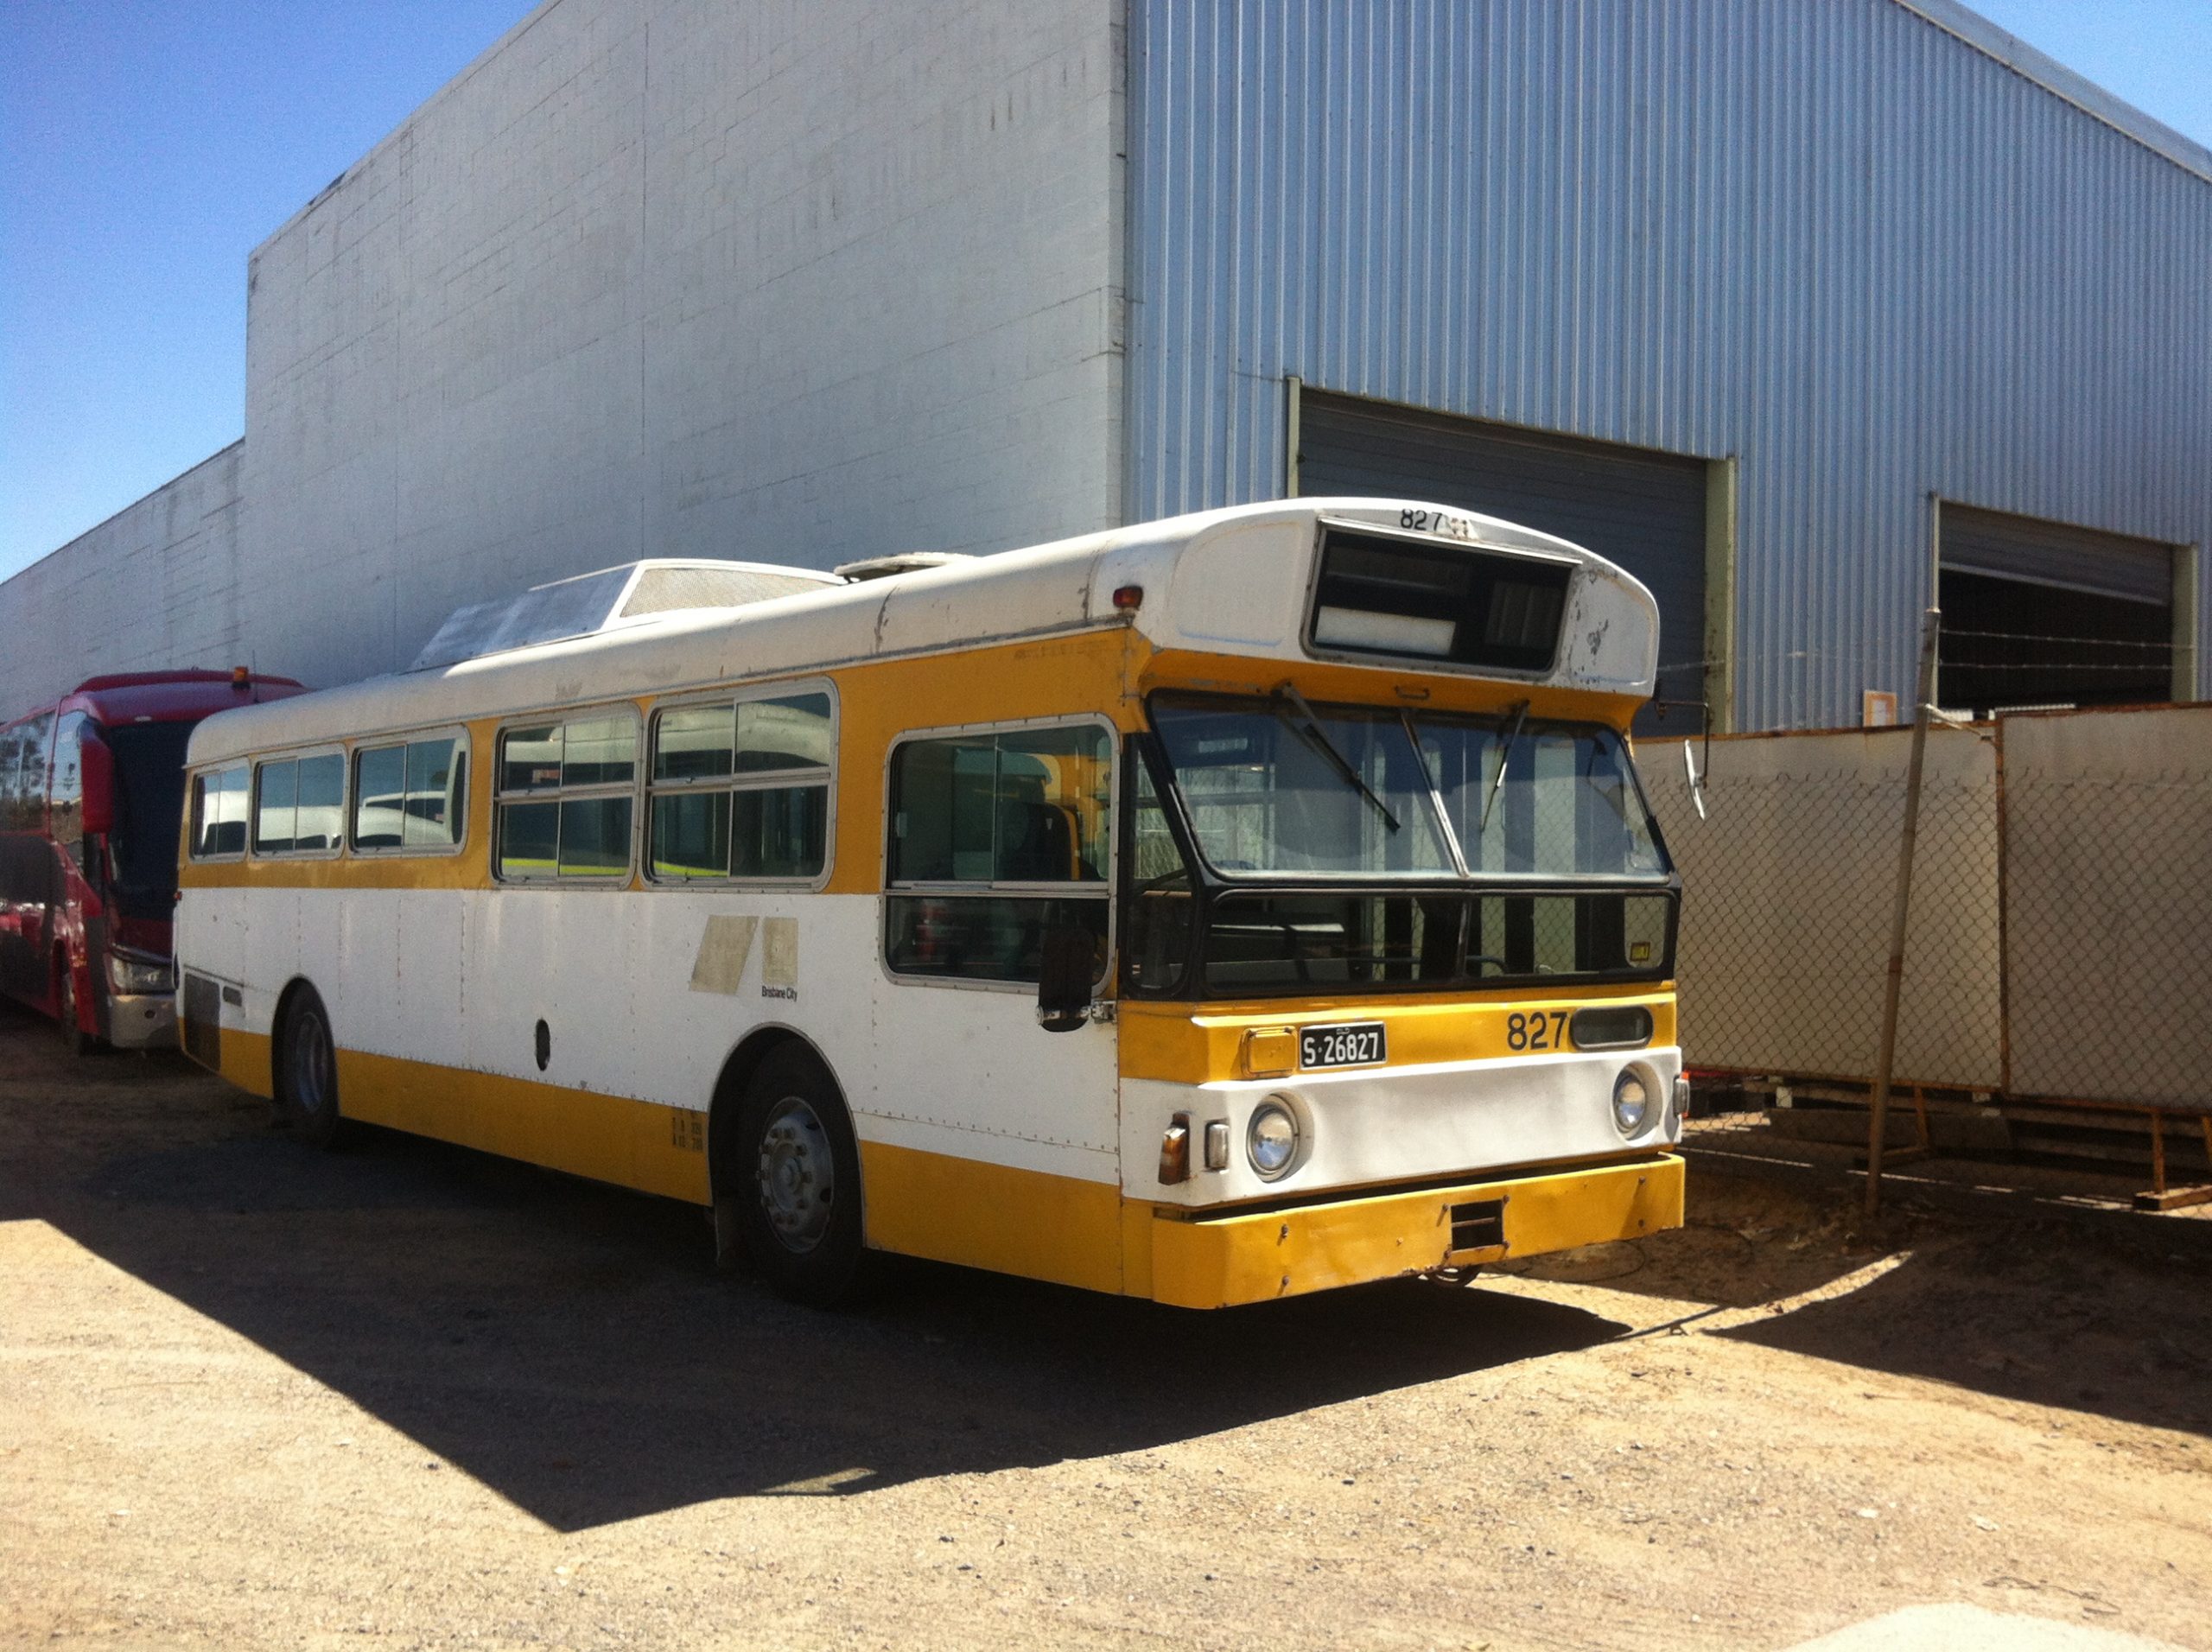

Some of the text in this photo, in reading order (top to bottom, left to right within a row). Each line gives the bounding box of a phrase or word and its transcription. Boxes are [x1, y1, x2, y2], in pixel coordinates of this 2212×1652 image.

[1401, 509, 1442, 531] 827
[761, 986, 798, 1002] Brisbane City
[1507, 1011, 1568, 1051] 827
